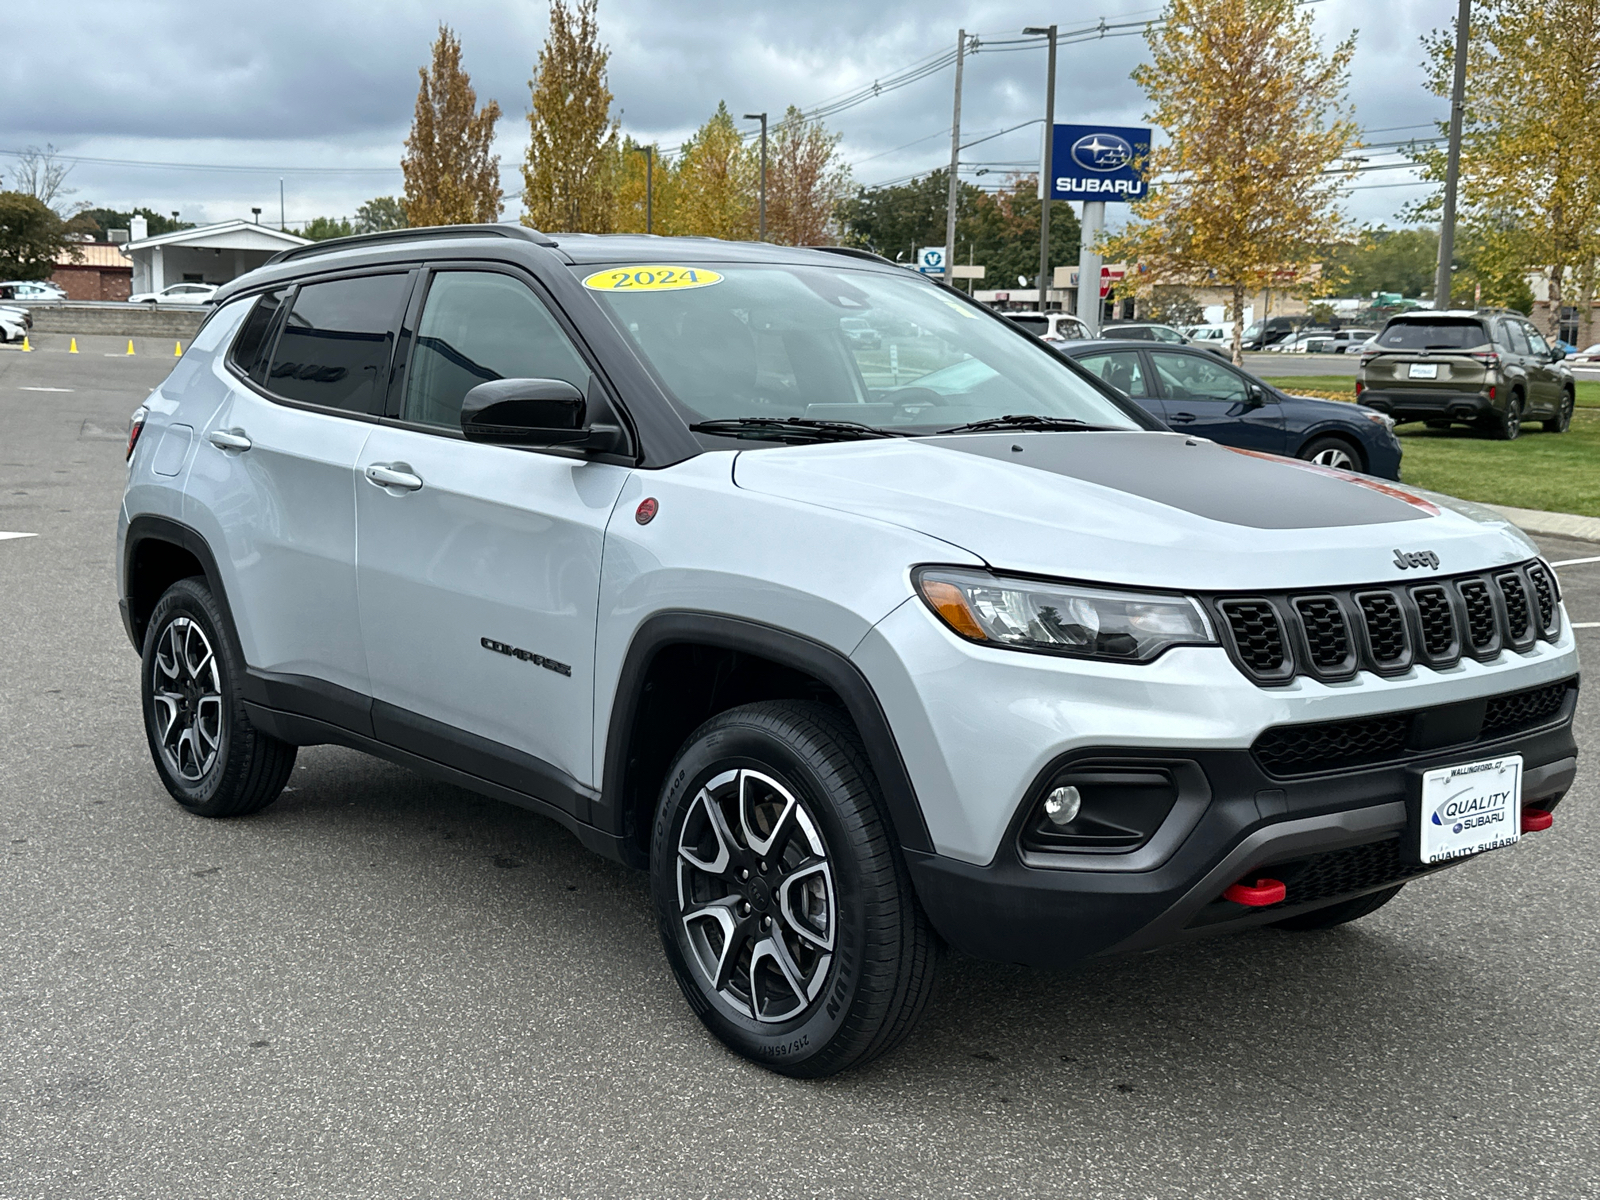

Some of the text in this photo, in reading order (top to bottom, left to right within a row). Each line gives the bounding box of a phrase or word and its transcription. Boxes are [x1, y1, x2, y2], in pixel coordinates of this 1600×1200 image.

[1056, 177, 1142, 195] SUBARU
[611, 270, 702, 288] 2024
[1393, 549, 1440, 570] Jeep
[480, 636, 572, 678] COMPASS
[1446, 790, 1510, 817] QUALITY
[1463, 811, 1505, 830] SUBARU
[1429, 835, 1519, 863] QUALITY SUBARU
